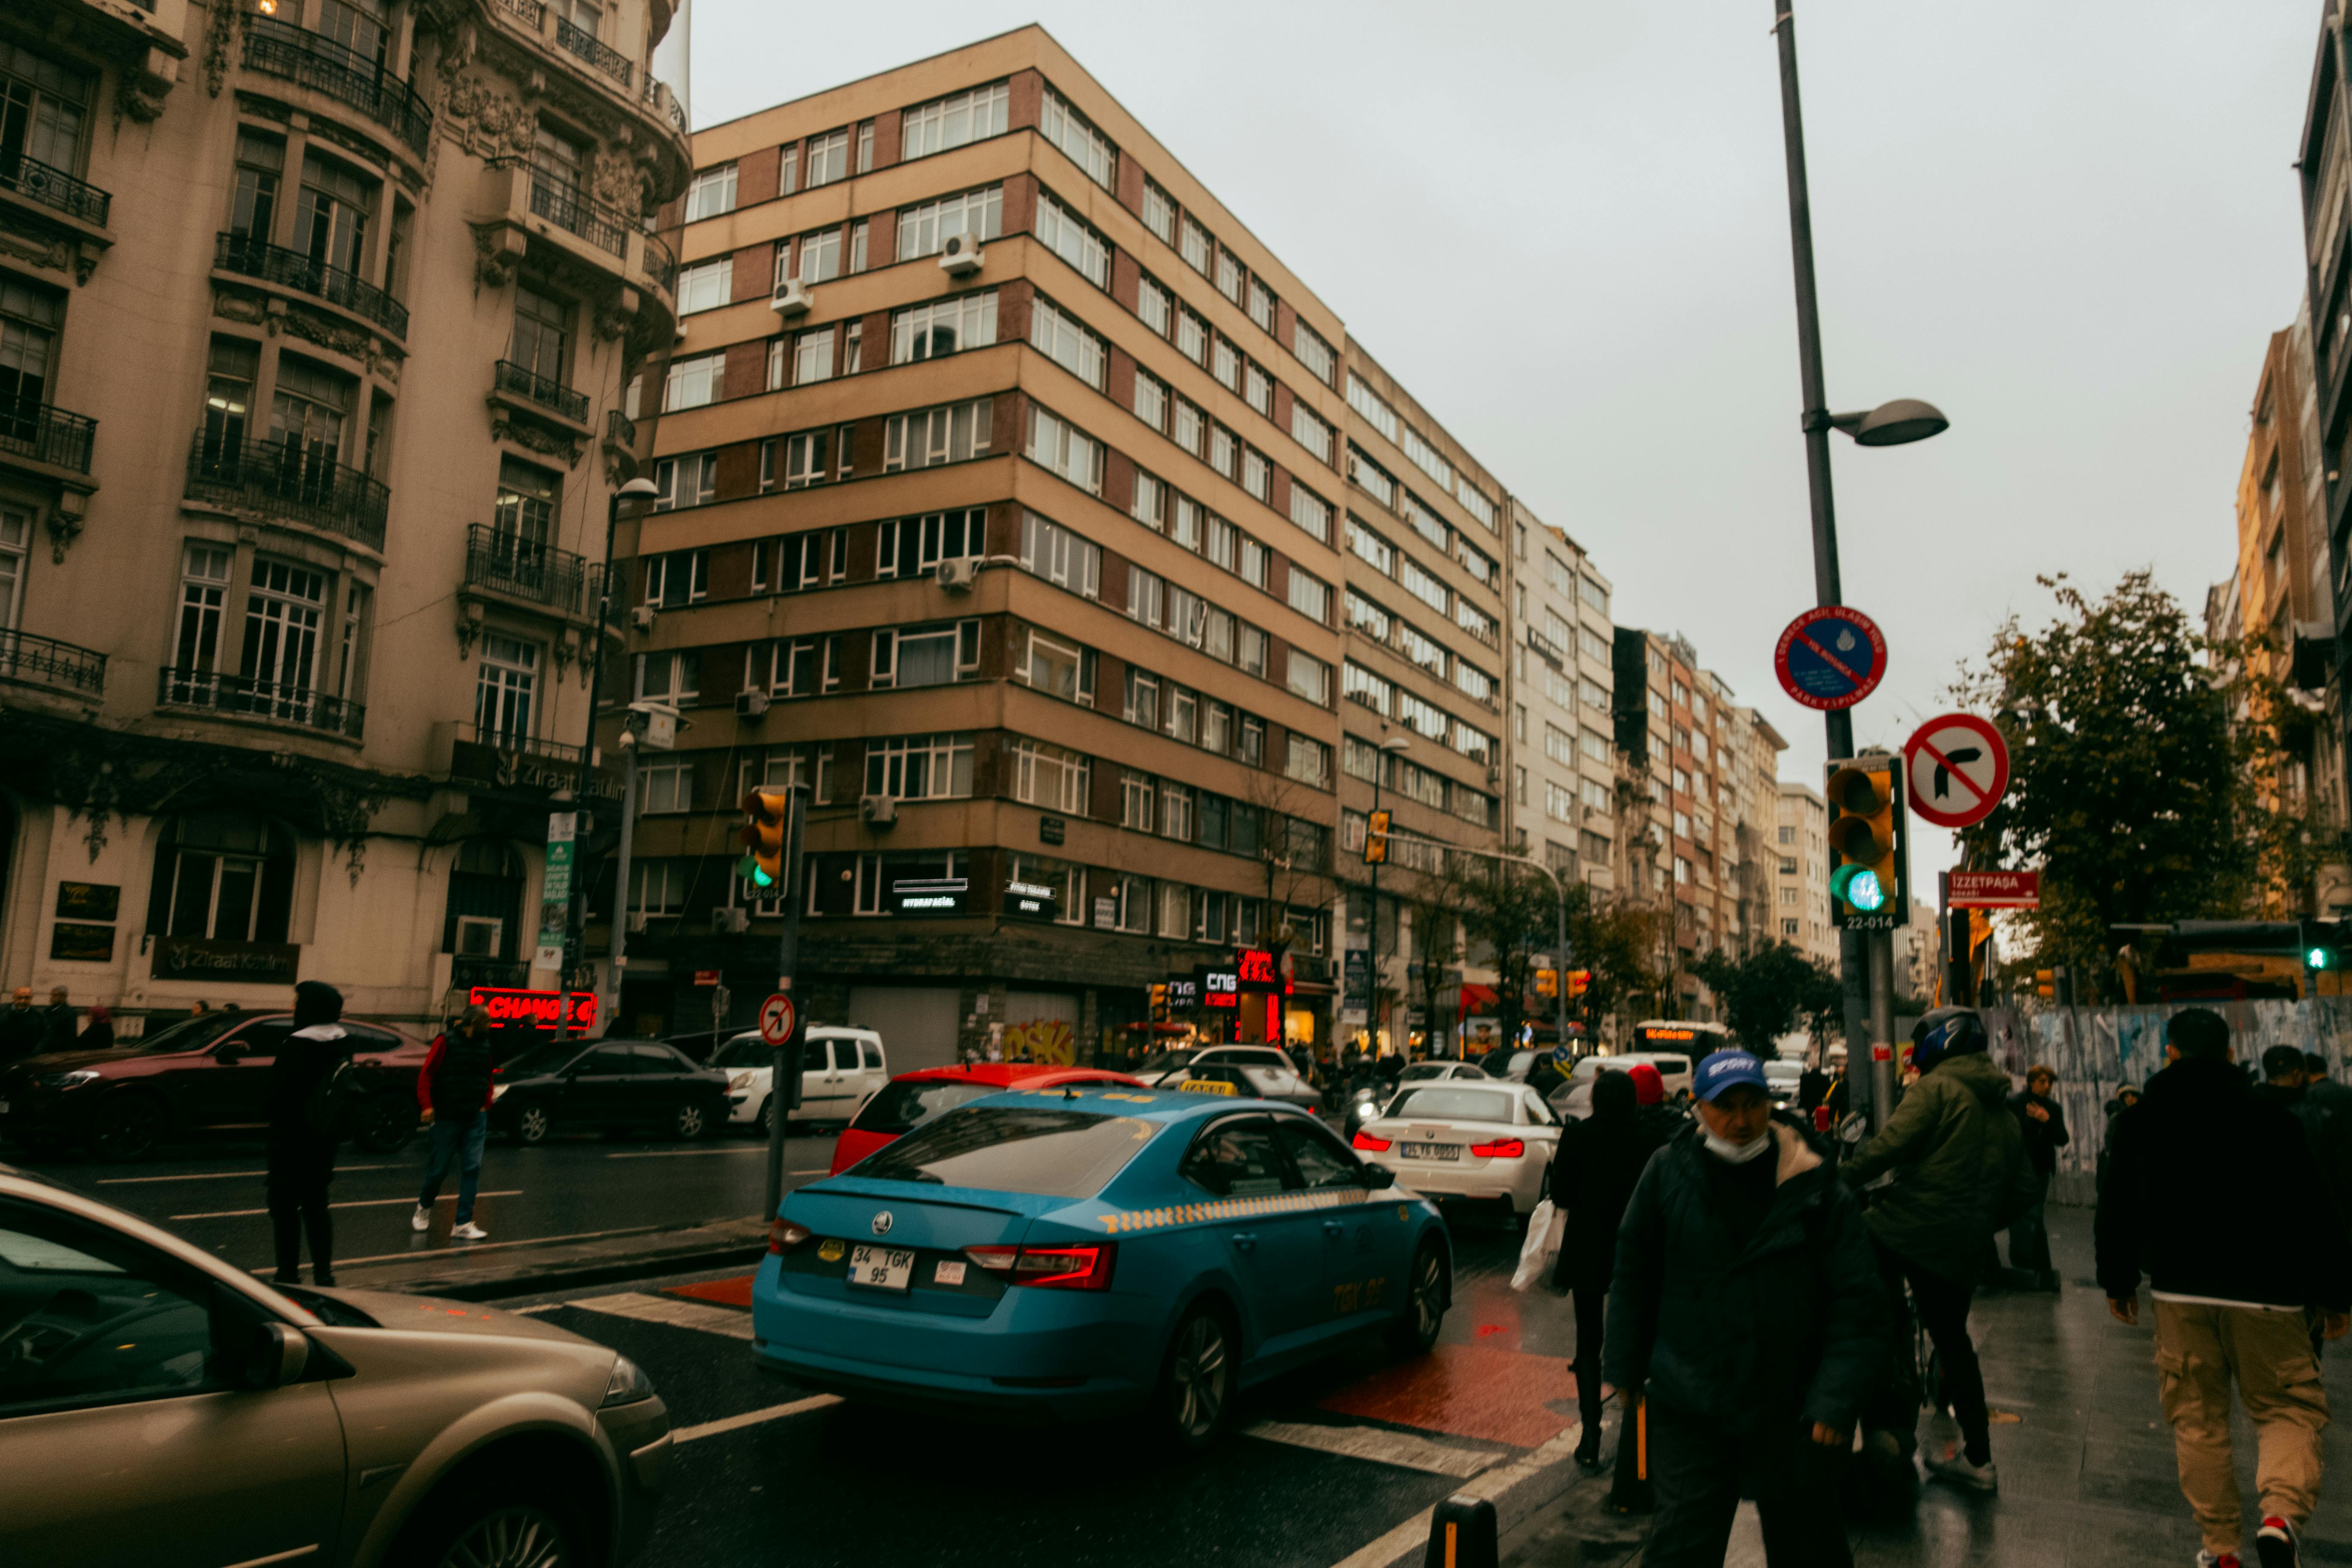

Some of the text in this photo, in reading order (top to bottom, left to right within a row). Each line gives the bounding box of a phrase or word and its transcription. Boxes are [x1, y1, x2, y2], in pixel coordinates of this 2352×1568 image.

[1790, 686, 1819, 707] PARK
[1822, 677, 1876, 707] YAPILMAZ
[521, 764, 577, 794] Ziraat
[1847, 915, 1894, 929] 22-014
[854, 1248, 872, 1264] 34
[884, 1250, 913, 1268] TGK
[871, 1267, 889, 1283] 95
